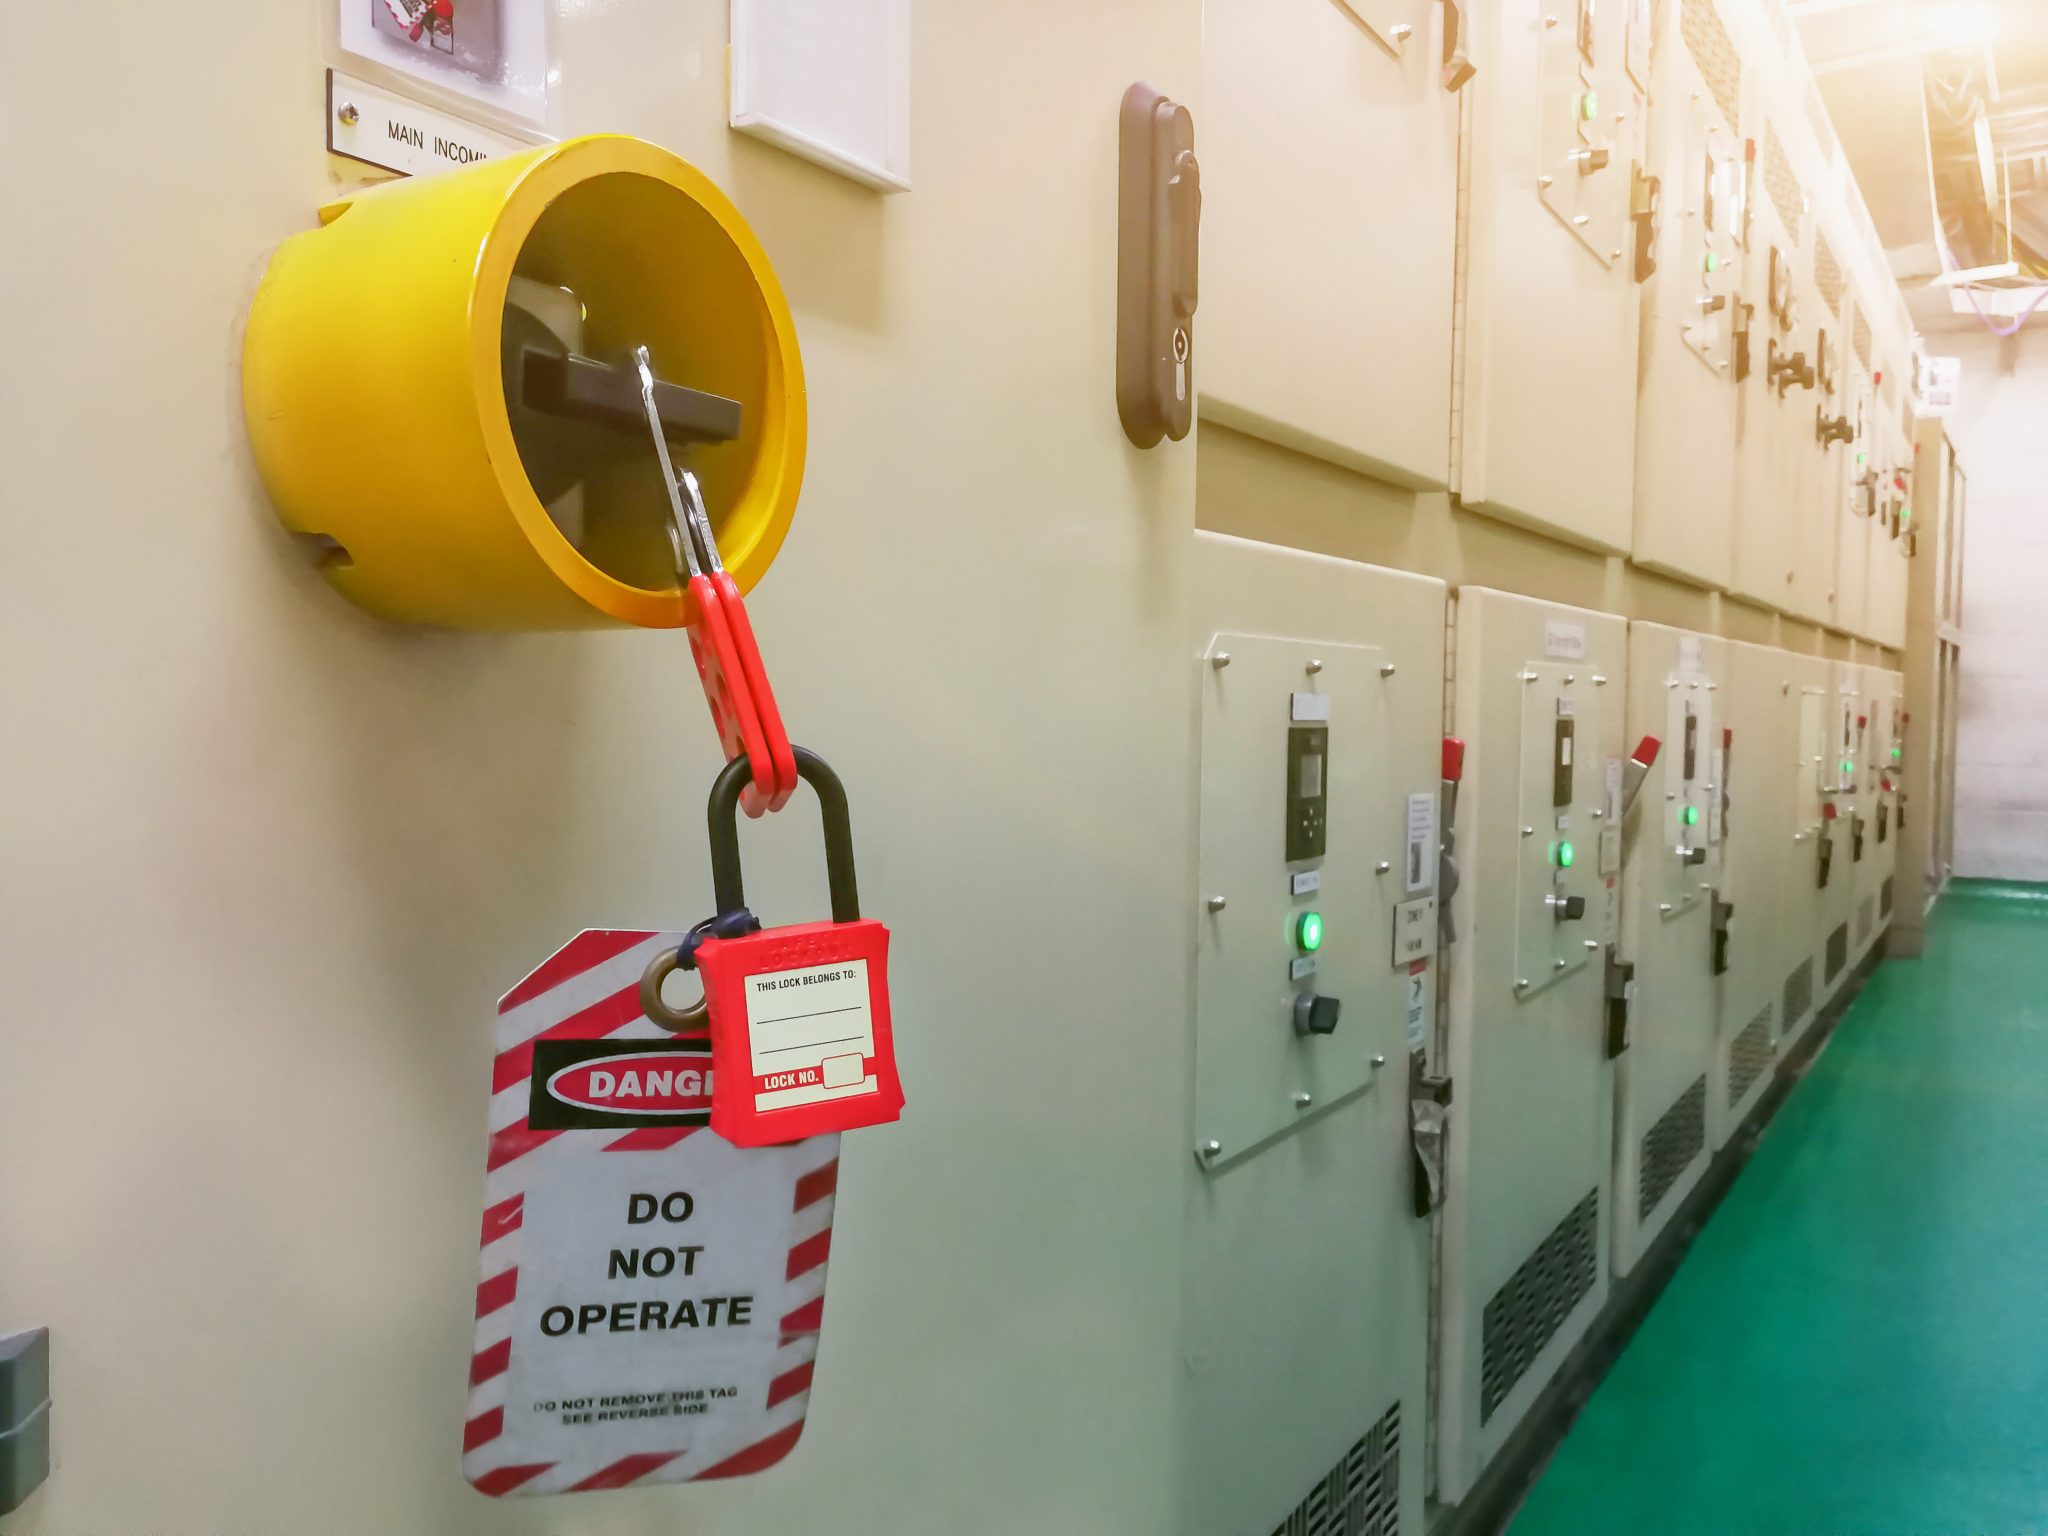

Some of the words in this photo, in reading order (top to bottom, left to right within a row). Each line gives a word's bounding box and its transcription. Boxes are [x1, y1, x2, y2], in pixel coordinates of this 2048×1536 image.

[387, 119, 424, 150] MAIN
[757, 981, 777, 992] THIS
[779, 977, 801, 989] LOCK
[803, 971, 841, 986] BELONGS
[843, 969, 857, 979] TO:
[764, 1073, 796, 1090] LOCK
[798, 1070, 820, 1084] NO.
[627, 1191, 694, 1225] DO
[607, 1246, 705, 1280] NOT
[540, 1296, 754, 1337] OPERATE
[533, 1401, 557, 1412] DO
[561, 1397, 596, 1410] NOT
[600, 1393, 667, 1408] REMOVE
[672, 1388, 705, 1403] THIS
[709, 1386, 738, 1399] TAG
[562, 1412, 593, 1425] SEE
[598, 1406, 669, 1421] REVERSE
[672, 1402, 709, 1417] SIDE
